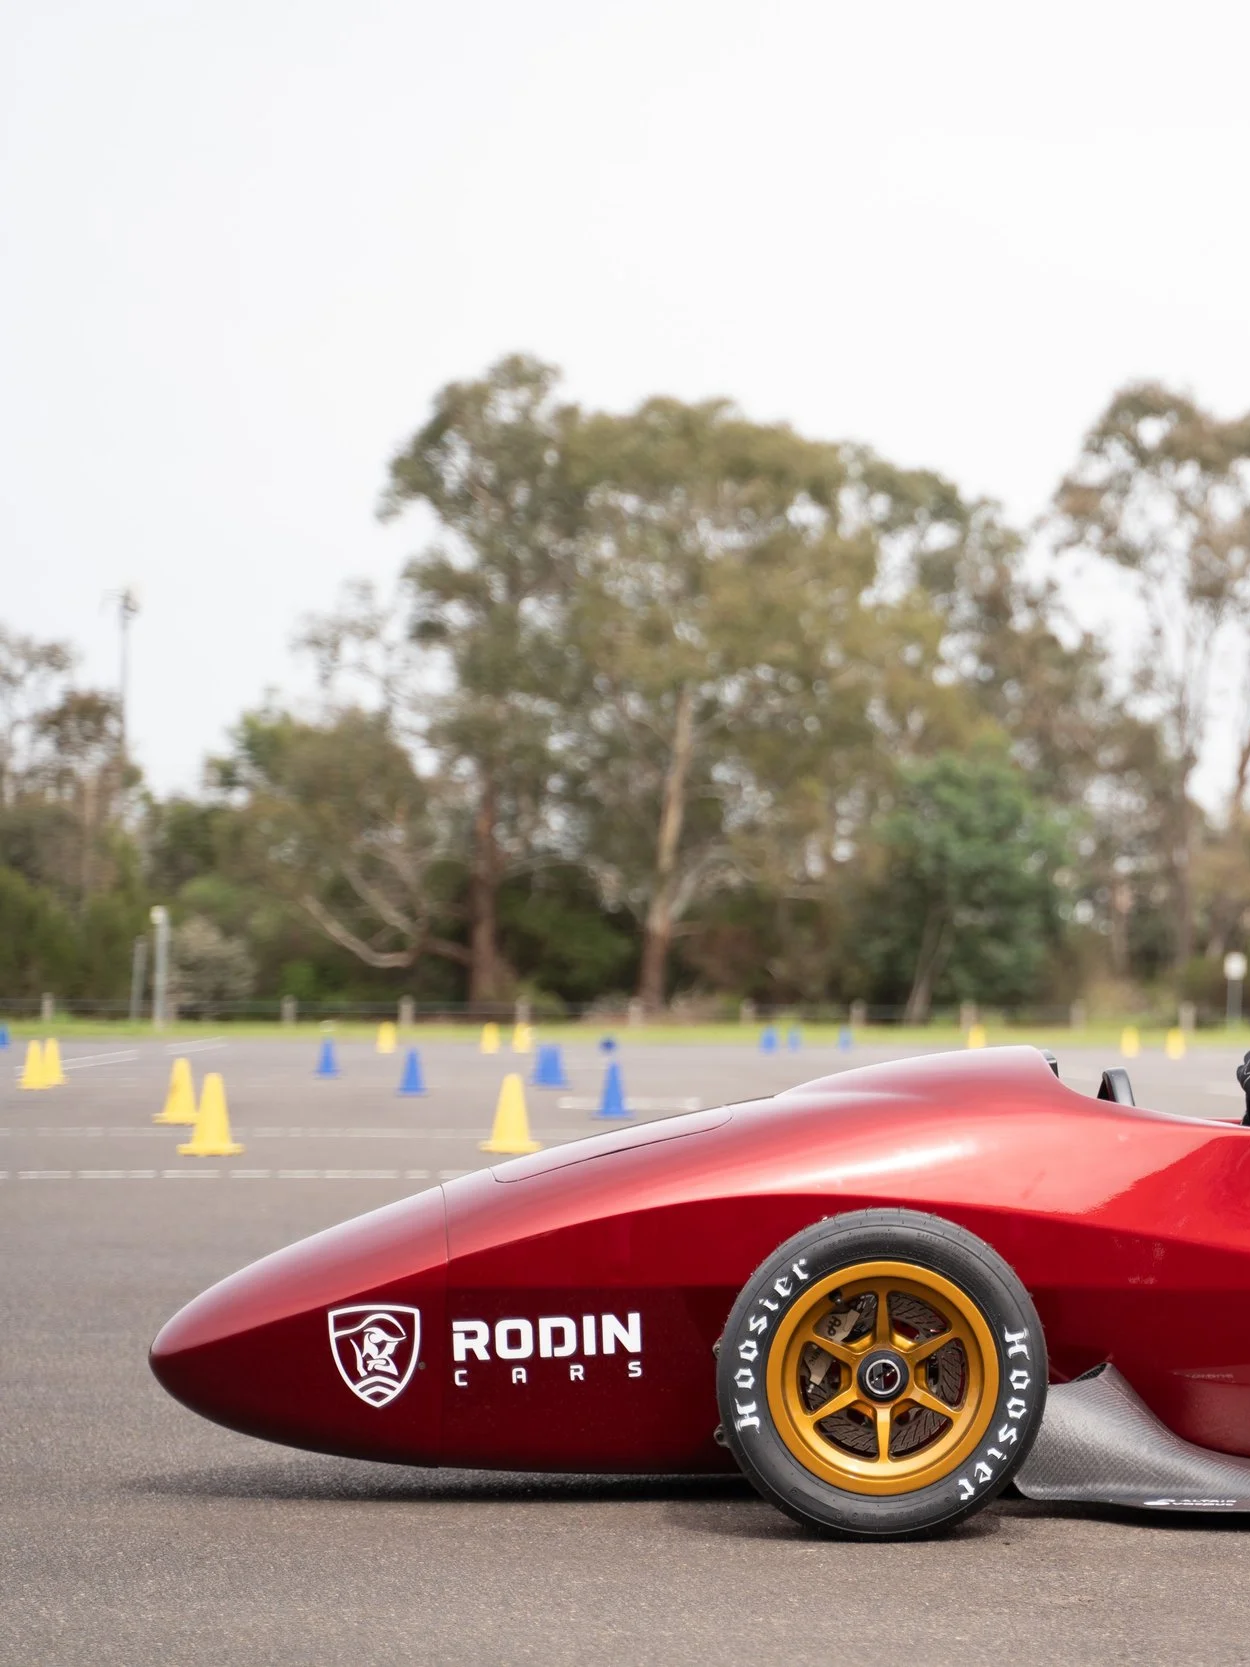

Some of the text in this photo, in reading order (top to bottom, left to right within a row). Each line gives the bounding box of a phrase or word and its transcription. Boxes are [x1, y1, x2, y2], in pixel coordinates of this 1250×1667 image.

[452, 1312, 642, 1361] RODIN
[454, 1361, 642, 1387] CARS
[733, 1258, 810, 1435] Hoosier
[957, 1323, 1031, 1501] Hoosier
